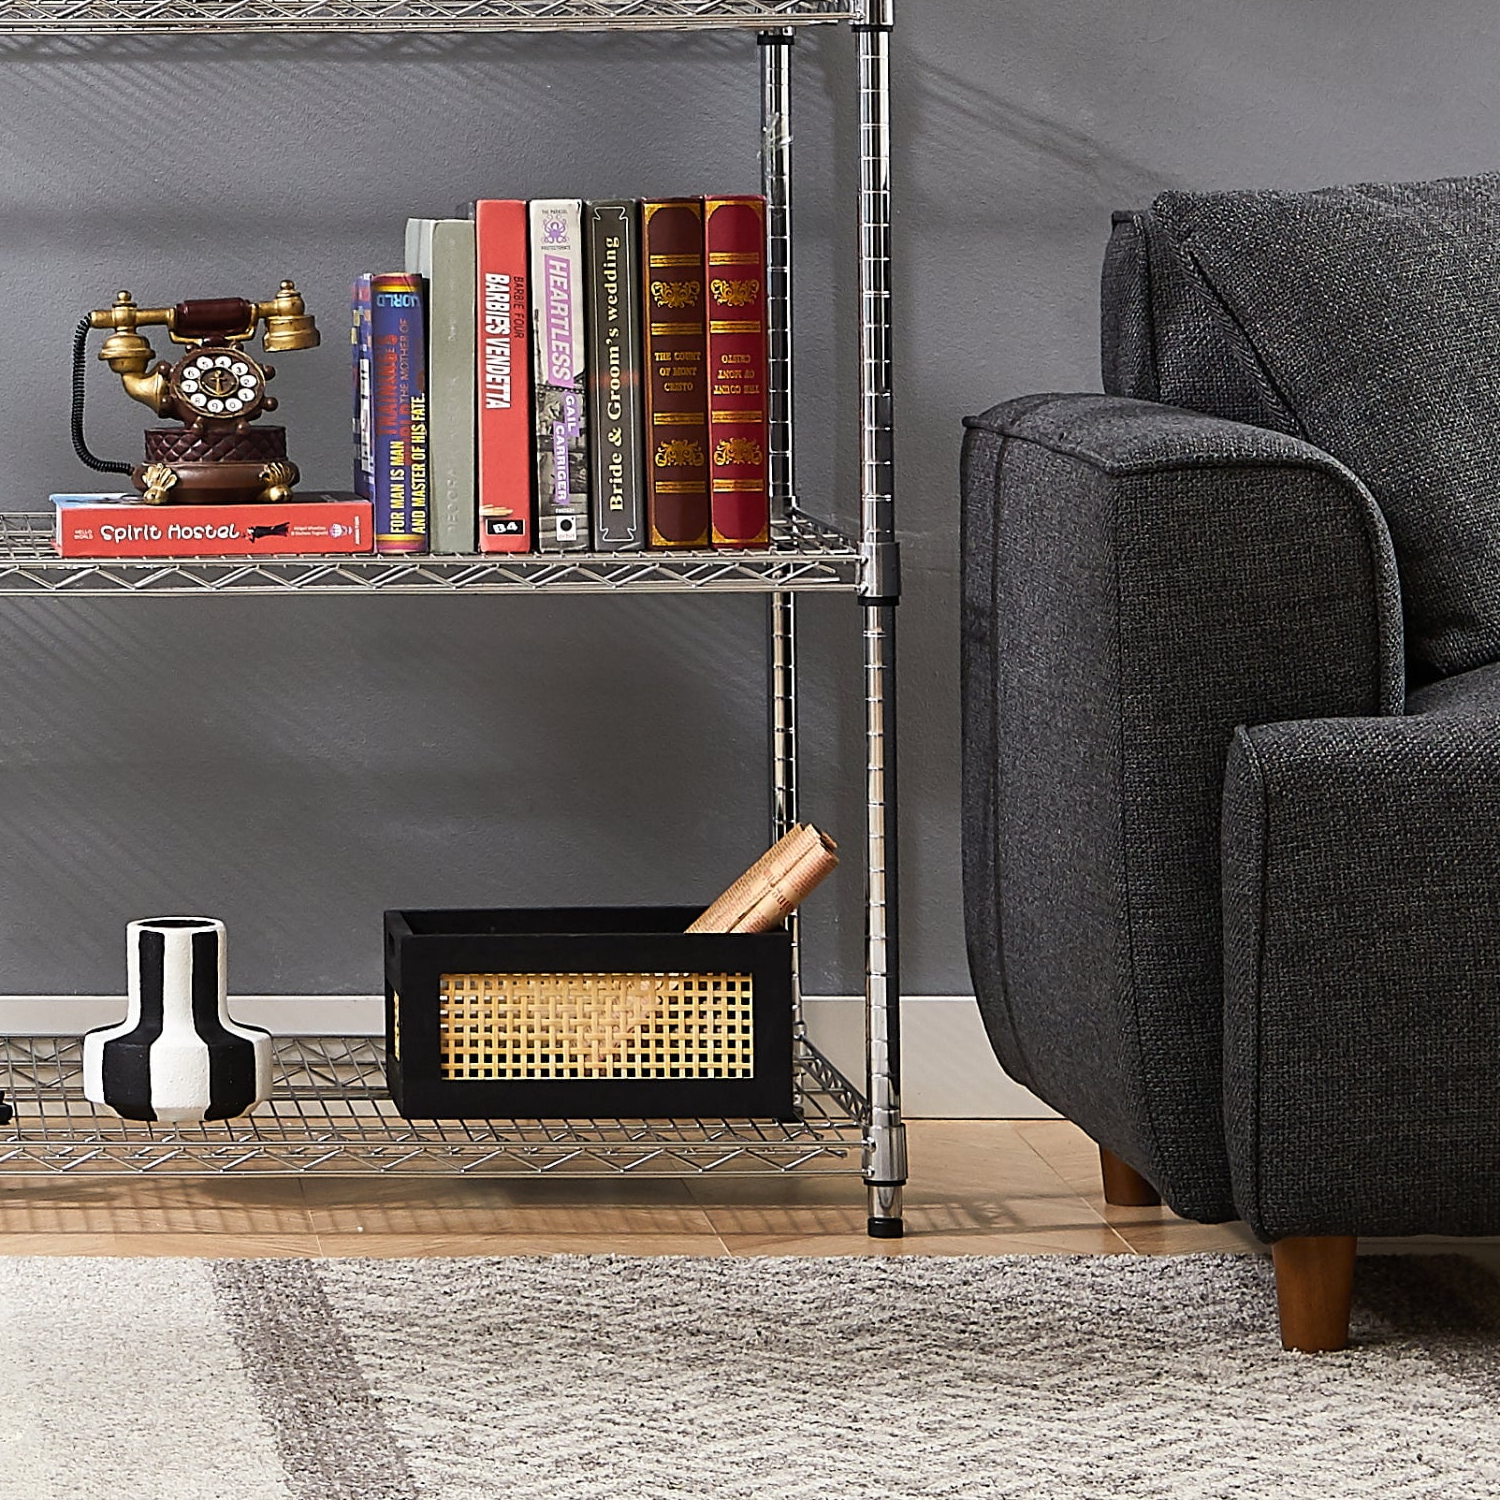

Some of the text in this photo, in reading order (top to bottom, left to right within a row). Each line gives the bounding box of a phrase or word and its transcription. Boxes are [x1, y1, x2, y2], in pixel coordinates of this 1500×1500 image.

[513, 276, 525, 339] BARBIE FOUR
[549, 259, 571, 382] HEARTLESS
[485, 273, 511, 409] BARBIES VENDETTA
[654, 352, 701, 361] THE COUNT
[659, 368, 671, 376] OF
[603, 236, 624, 512] Bride & Groom’s wedding
[664, 382, 693, 391] CRISTO
[565, 395, 577, 432] GAIL
[390, 441, 405, 534] FOR MAN IS MAN
[411, 392, 426, 534] AND MASTER OF HIS FATE.
[555, 425, 567, 501] CARRIGER
[100, 523, 240, 543] Spirit Hostel
[492, 521, 518, 534] B4
